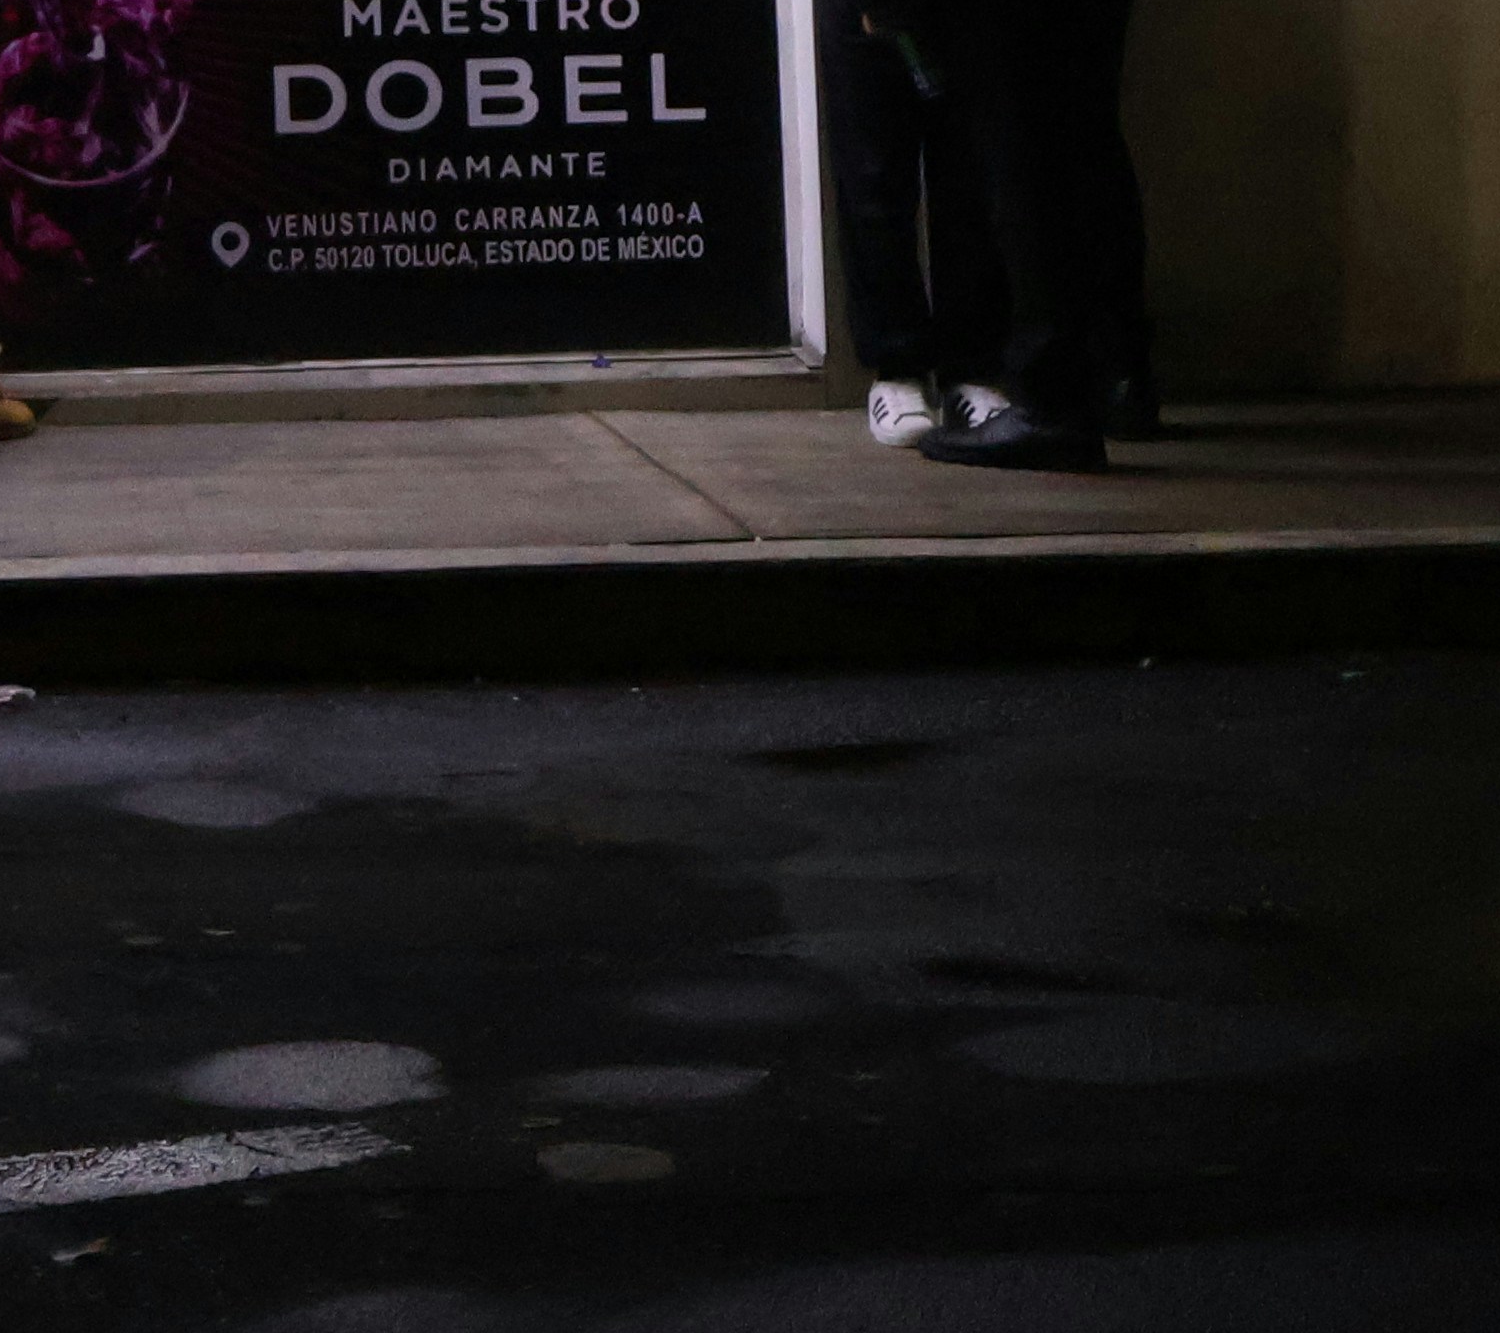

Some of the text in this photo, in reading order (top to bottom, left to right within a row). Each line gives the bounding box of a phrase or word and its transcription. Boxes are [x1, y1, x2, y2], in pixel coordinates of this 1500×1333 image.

[273, 52, 707, 134] DOBEL
[388, 151, 606, 184] DIAMANTE
[265, 200, 704, 237] VENUSTIANO CARRANZA 1400-A
[268, 231, 705, 271] C.P. 50120 TOLUCA, ESTADO DE MÉXICO
